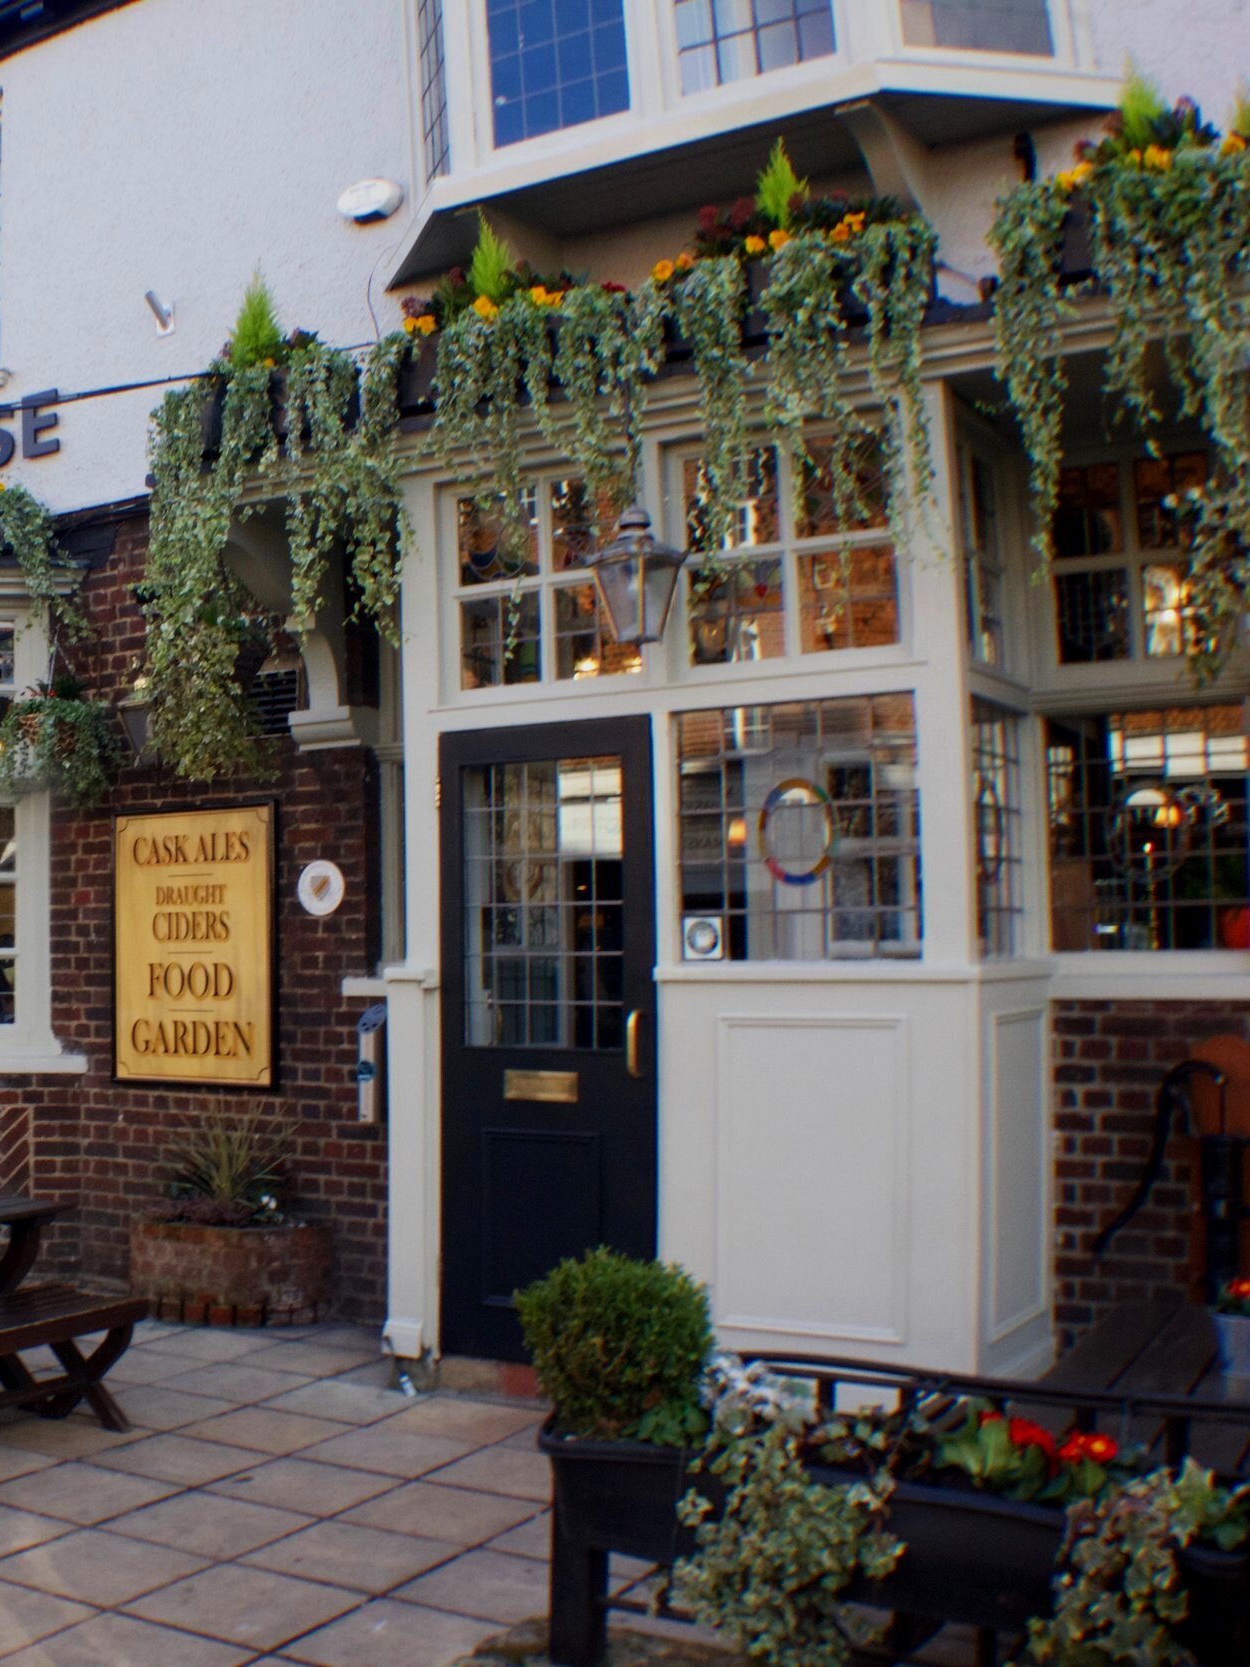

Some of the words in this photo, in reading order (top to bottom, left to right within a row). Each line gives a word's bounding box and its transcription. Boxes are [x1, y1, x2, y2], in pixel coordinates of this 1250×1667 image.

[133, 833, 189, 866] CASK
[193, 830, 250, 864] ALES
[155, 883, 228, 906] DRAUGHT
[152, 910, 230, 942] CIDERS
[148, 962, 234, 1000] FOOD
[131, 1018, 253, 1058] GARDEN
